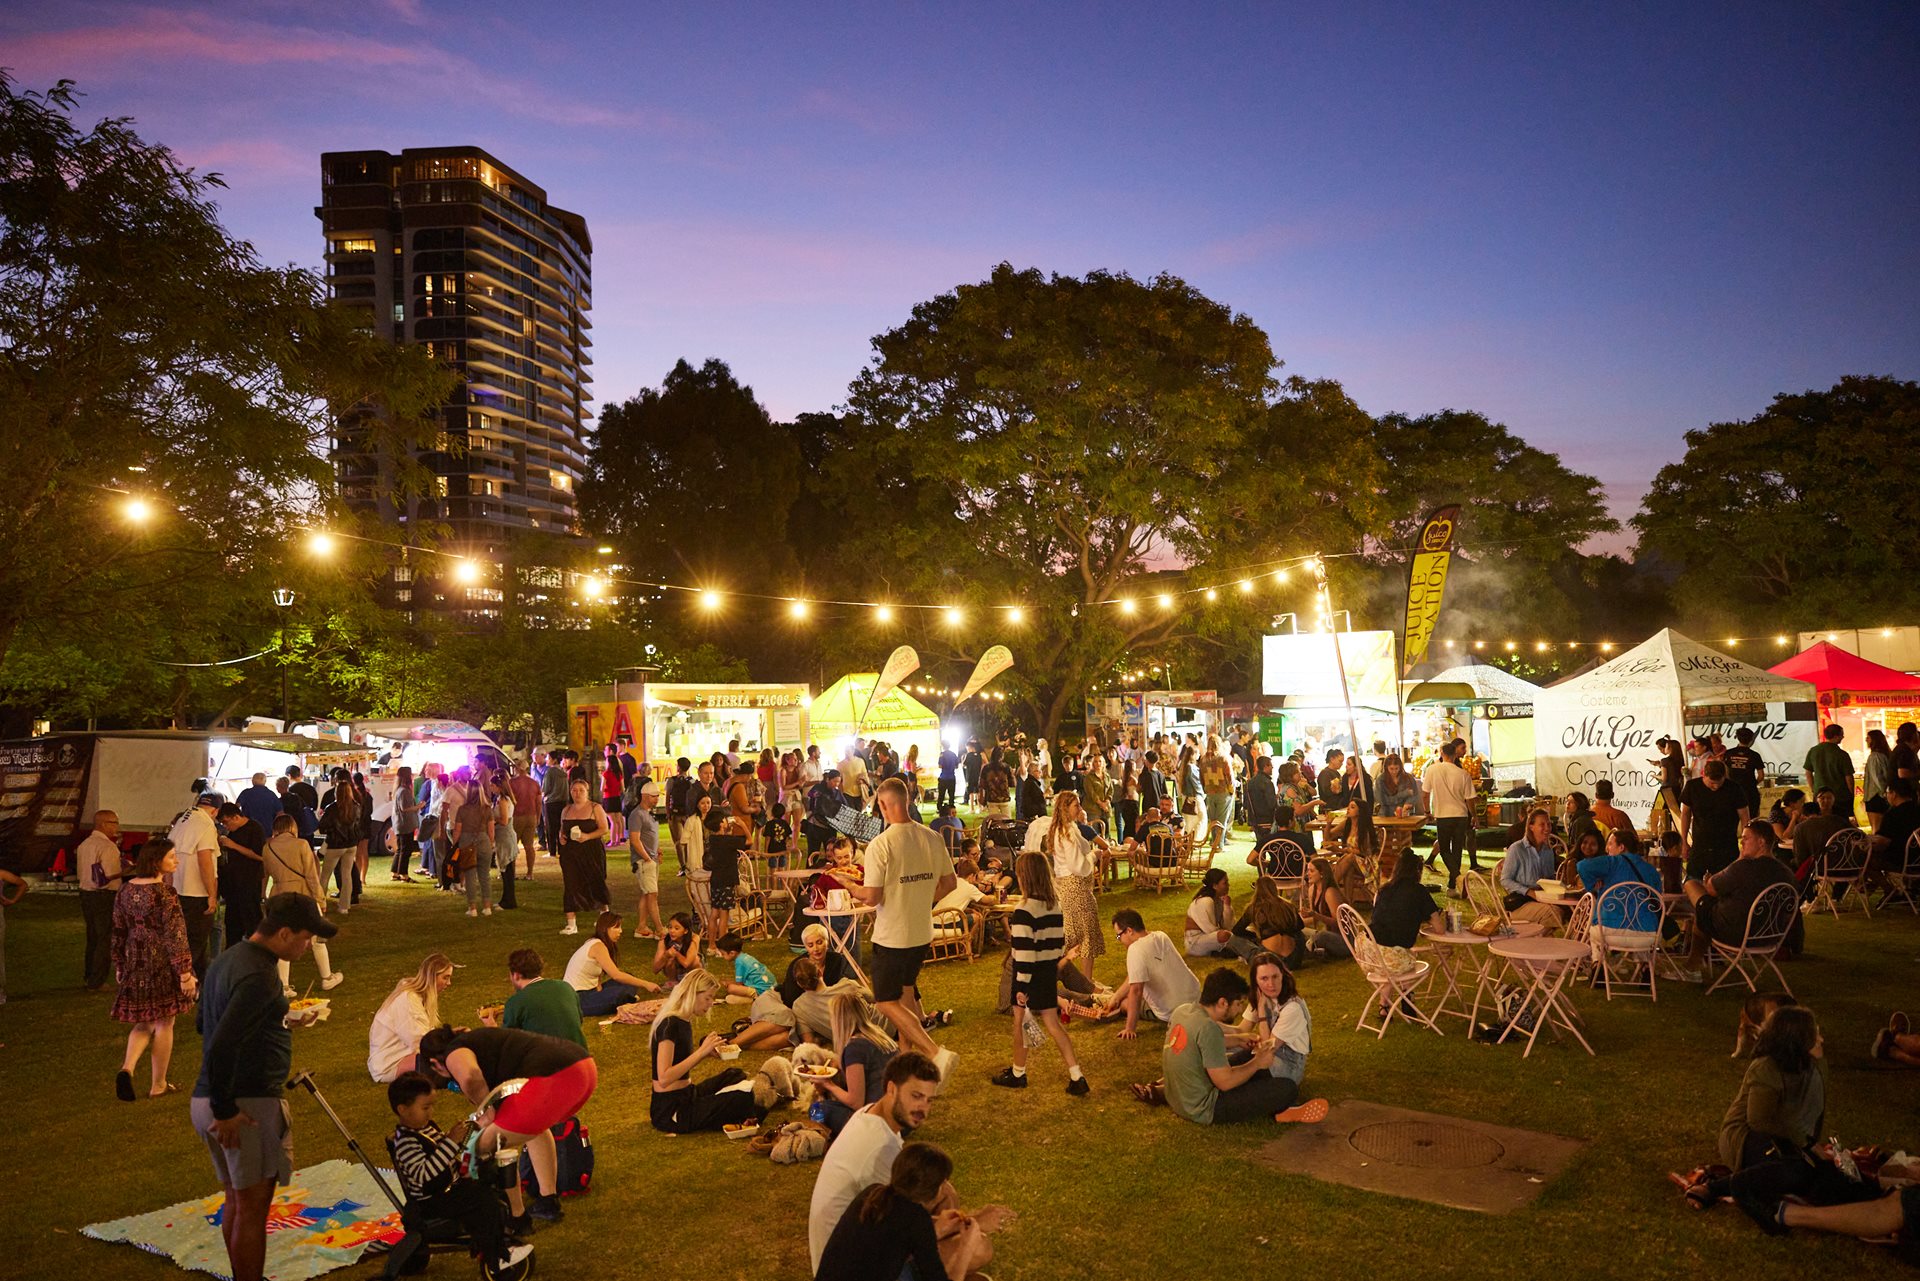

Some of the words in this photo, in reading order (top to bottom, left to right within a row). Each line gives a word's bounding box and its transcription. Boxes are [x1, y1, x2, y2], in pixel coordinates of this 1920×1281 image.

[1407, 572, 1427, 640] JUICE
[1424, 555, 1446, 643] TATION
[1679, 656, 1744, 673] Mr.Goz
[707, 694, 751, 707] BIRRIA
[756, 694, 790, 706] TACOS
[1855, 695, 1890, 704] AUTHENTIC
[1890, 695, 1912, 704] INDIAN
[1561, 714, 1655, 760] Mr.Goz
[12, 753, 31, 766] Thai
[32, 752, 54, 763] Food
[1565, 761, 1661, 787] Gozleme
[1610, 798, 1638, 809] Always
